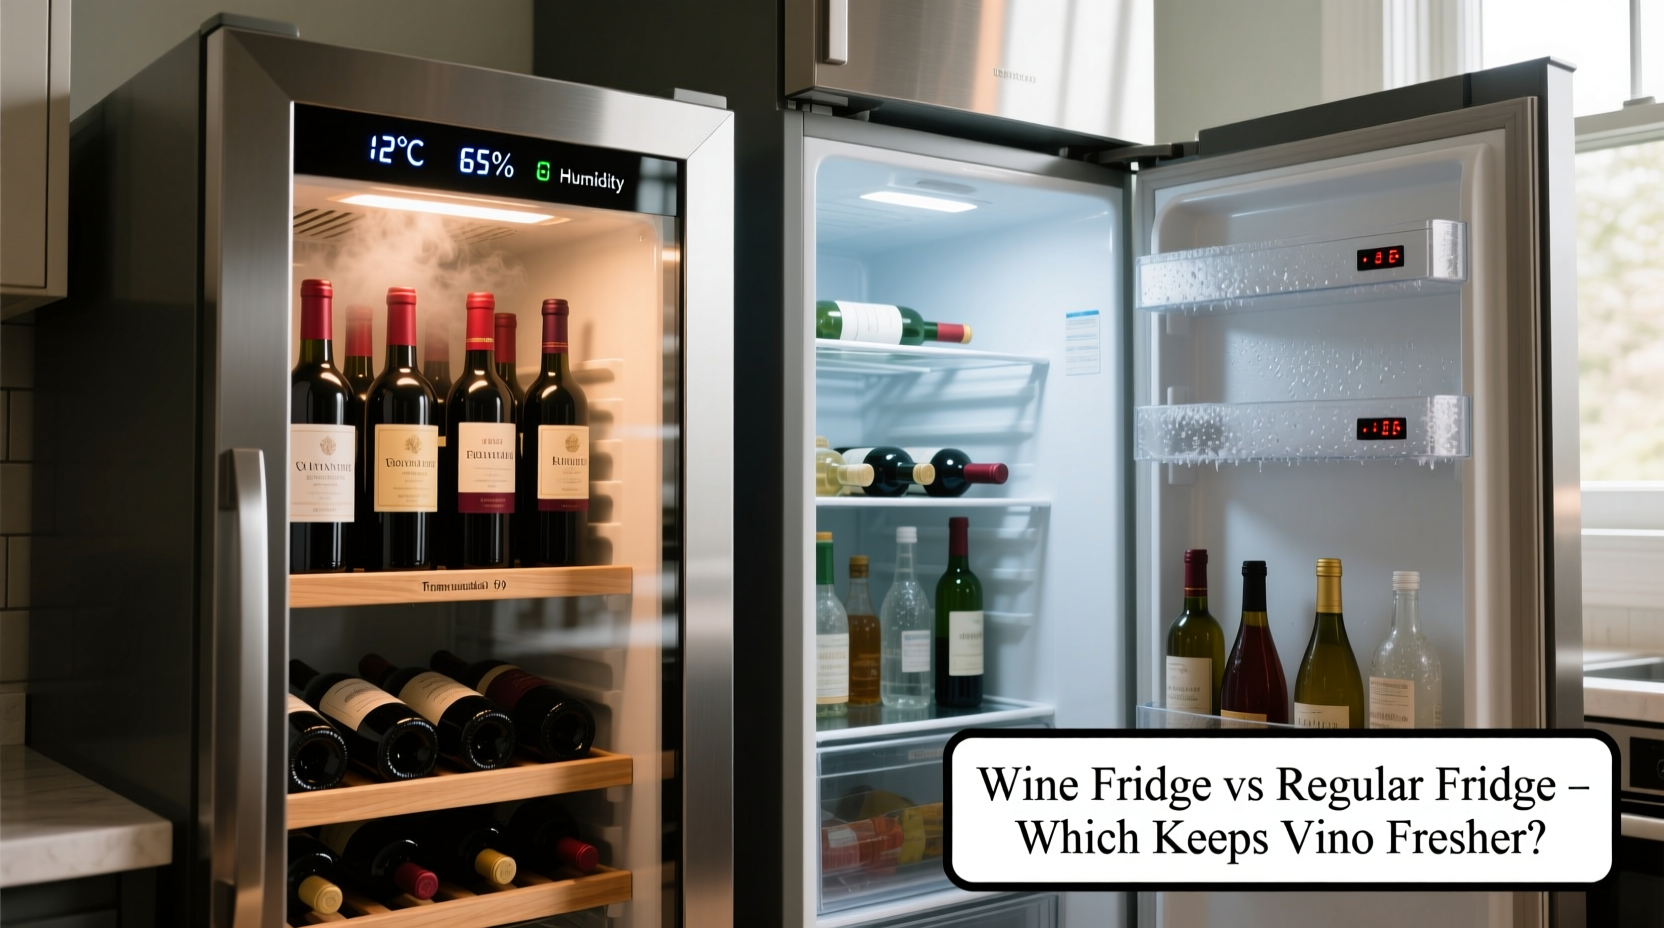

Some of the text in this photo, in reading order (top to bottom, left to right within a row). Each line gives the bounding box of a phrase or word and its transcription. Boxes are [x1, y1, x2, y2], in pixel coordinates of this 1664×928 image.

[370, 135, 424, 167] 12°C
[460, 147, 514, 178] 65%
[560, 168, 625, 194] Humidity
